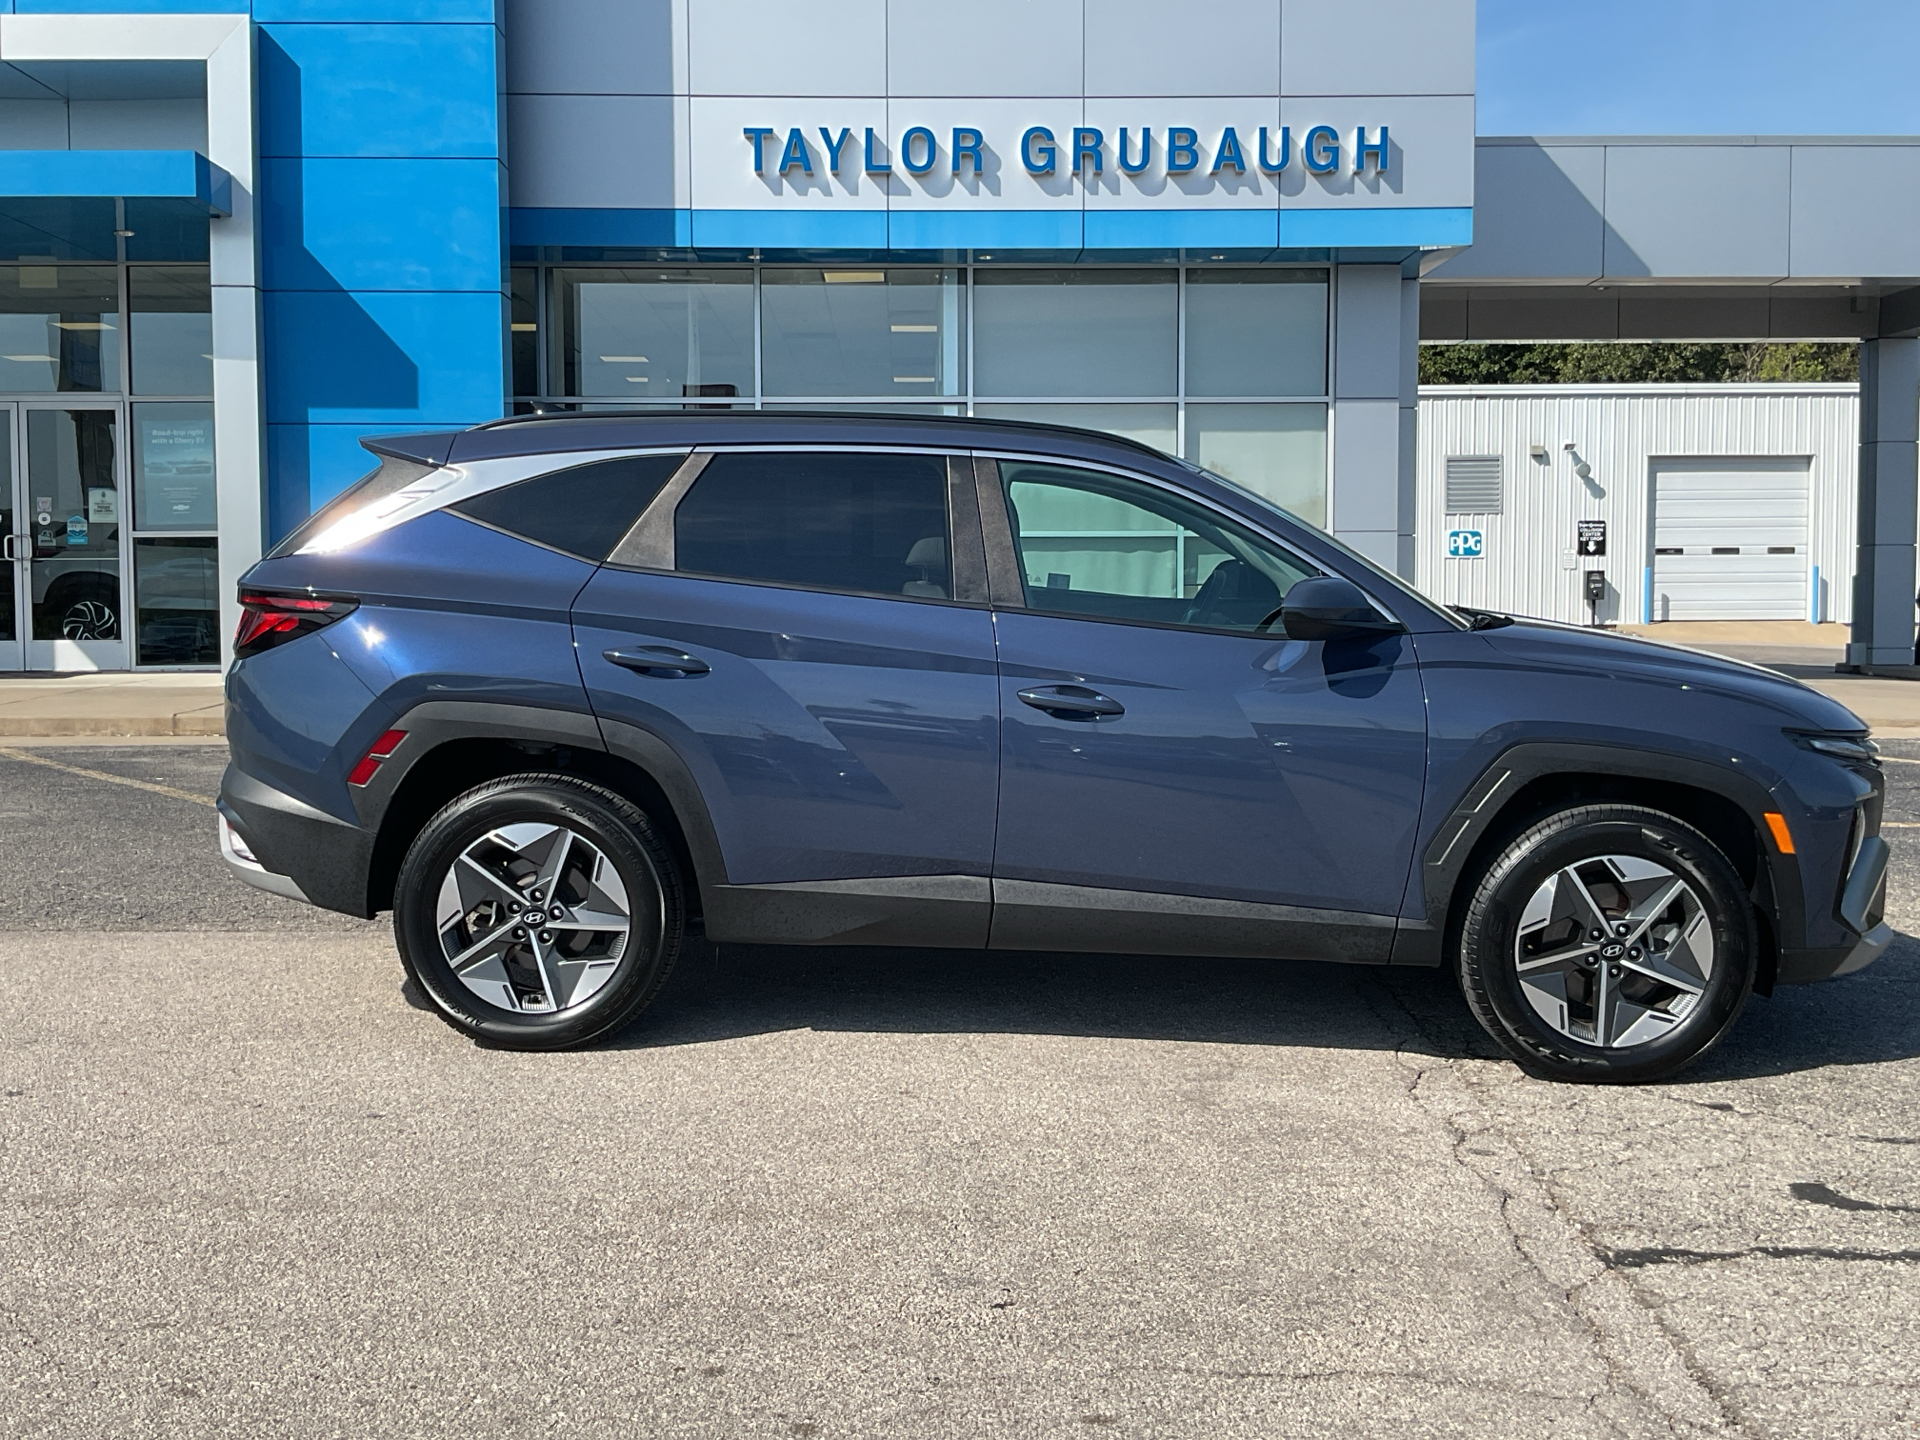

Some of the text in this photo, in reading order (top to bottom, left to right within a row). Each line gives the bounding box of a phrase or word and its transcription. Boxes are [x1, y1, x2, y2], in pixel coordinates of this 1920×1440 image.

[743, 125, 1389, 175] TAYLOR GRUBAUGH
[152, 429, 186, 437] Road-trip
[1450, 532, 1482, 555] PPG
[427, 976, 485, 1027] ALL-SEASON
